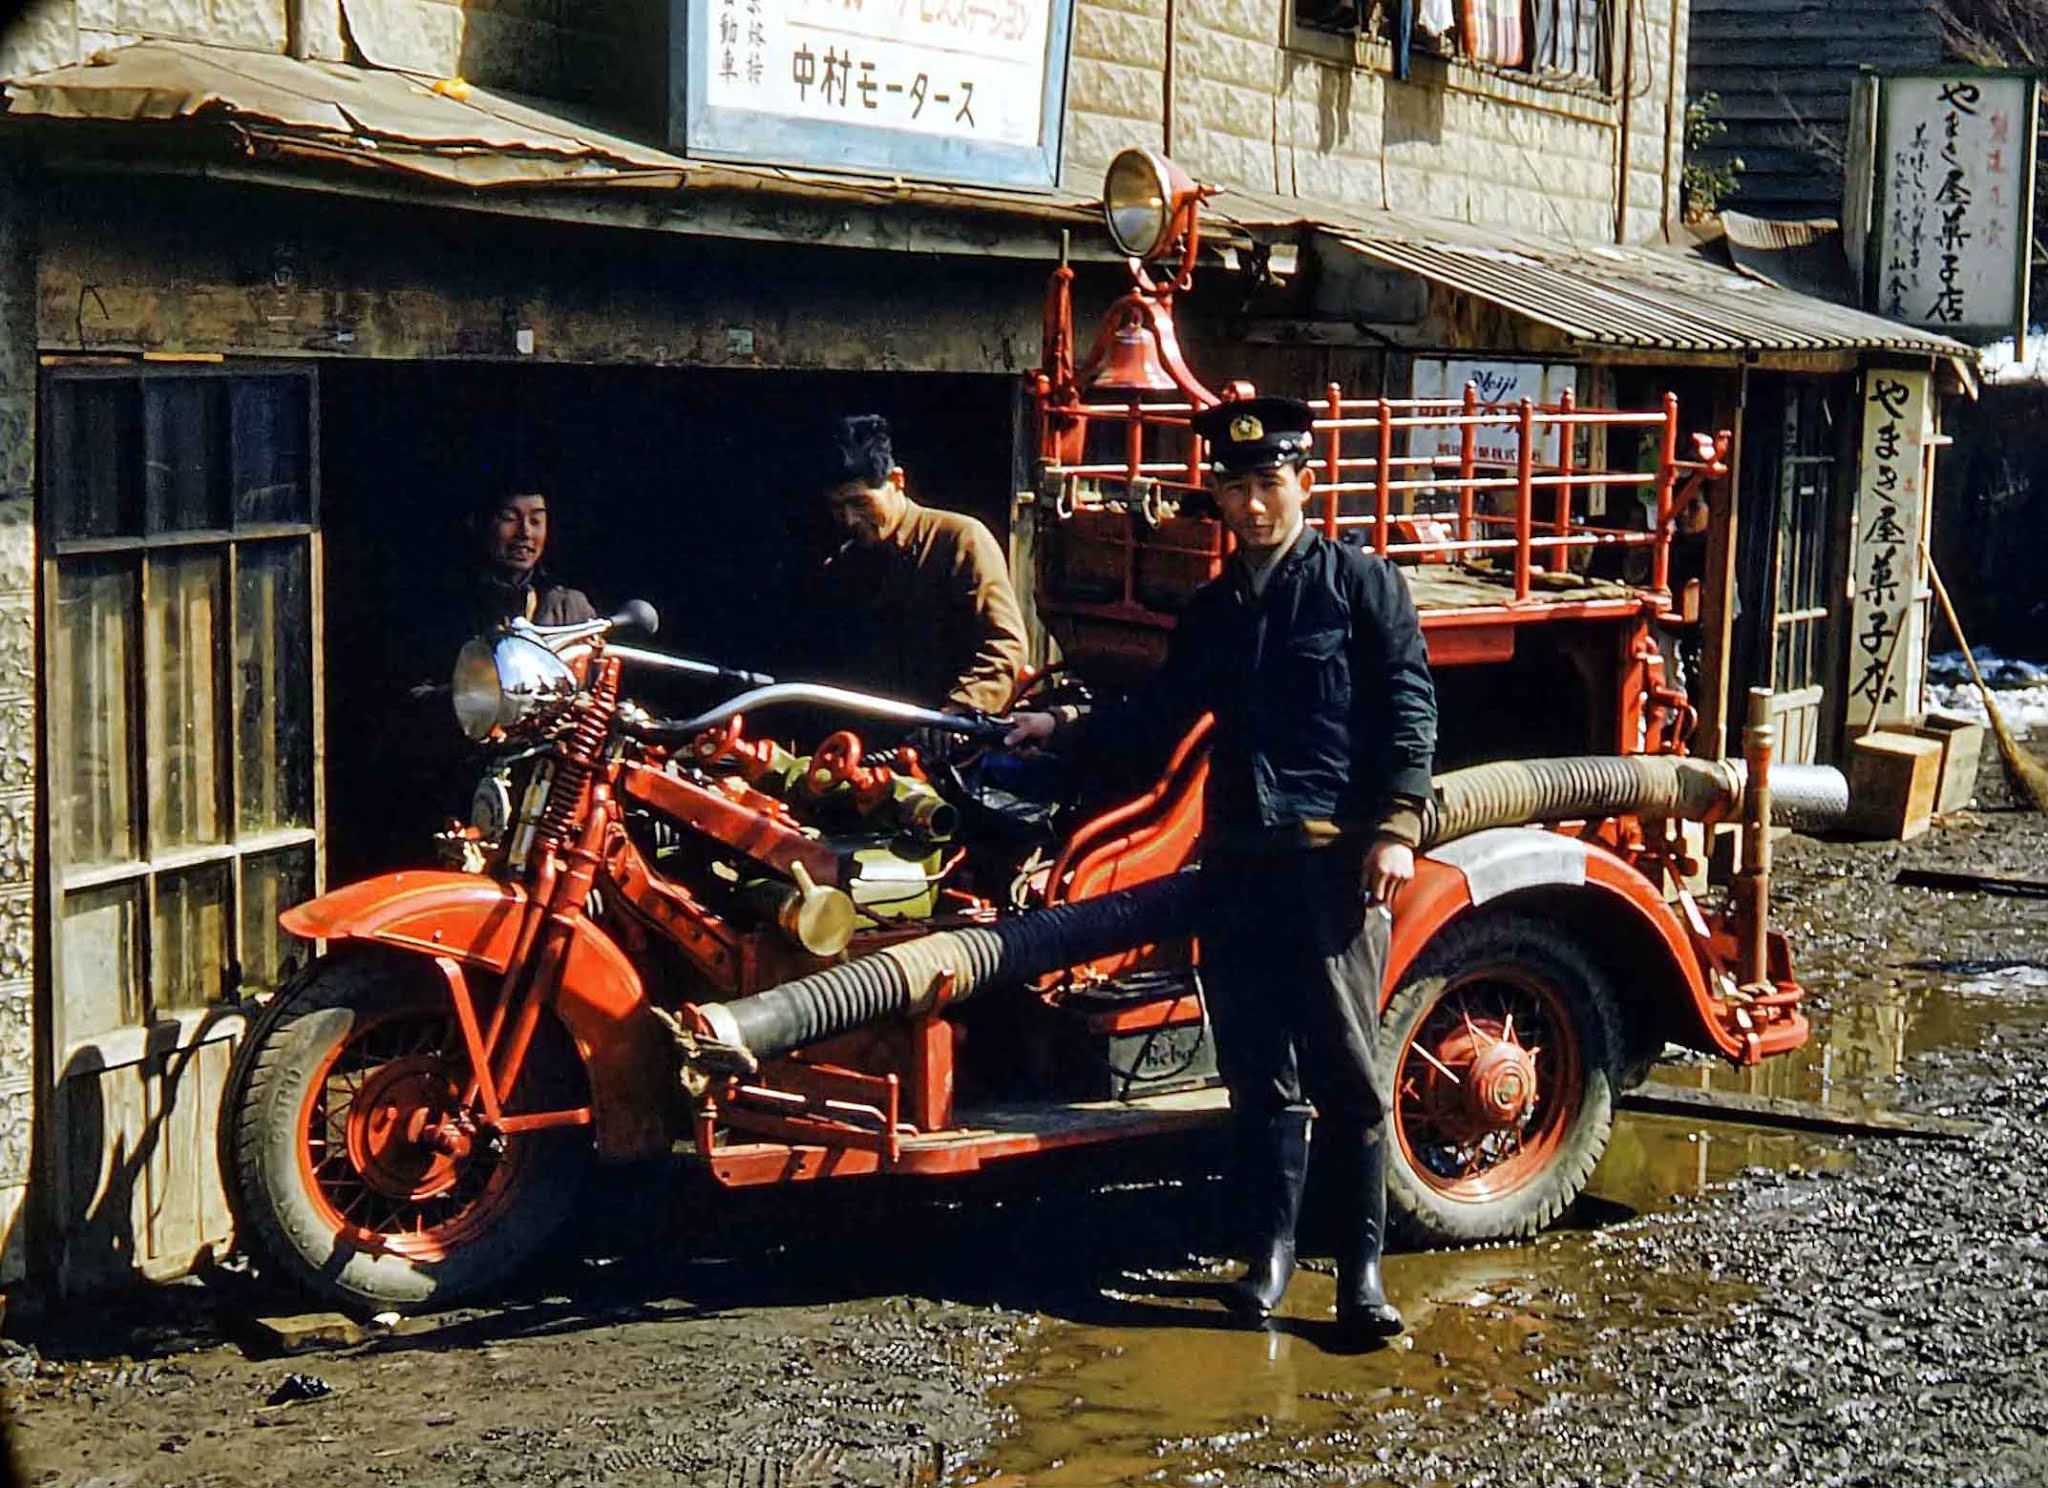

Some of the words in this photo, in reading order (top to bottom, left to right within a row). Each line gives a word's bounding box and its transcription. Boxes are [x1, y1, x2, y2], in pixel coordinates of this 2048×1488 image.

[793, 43, 976, 128] 中村モータース
